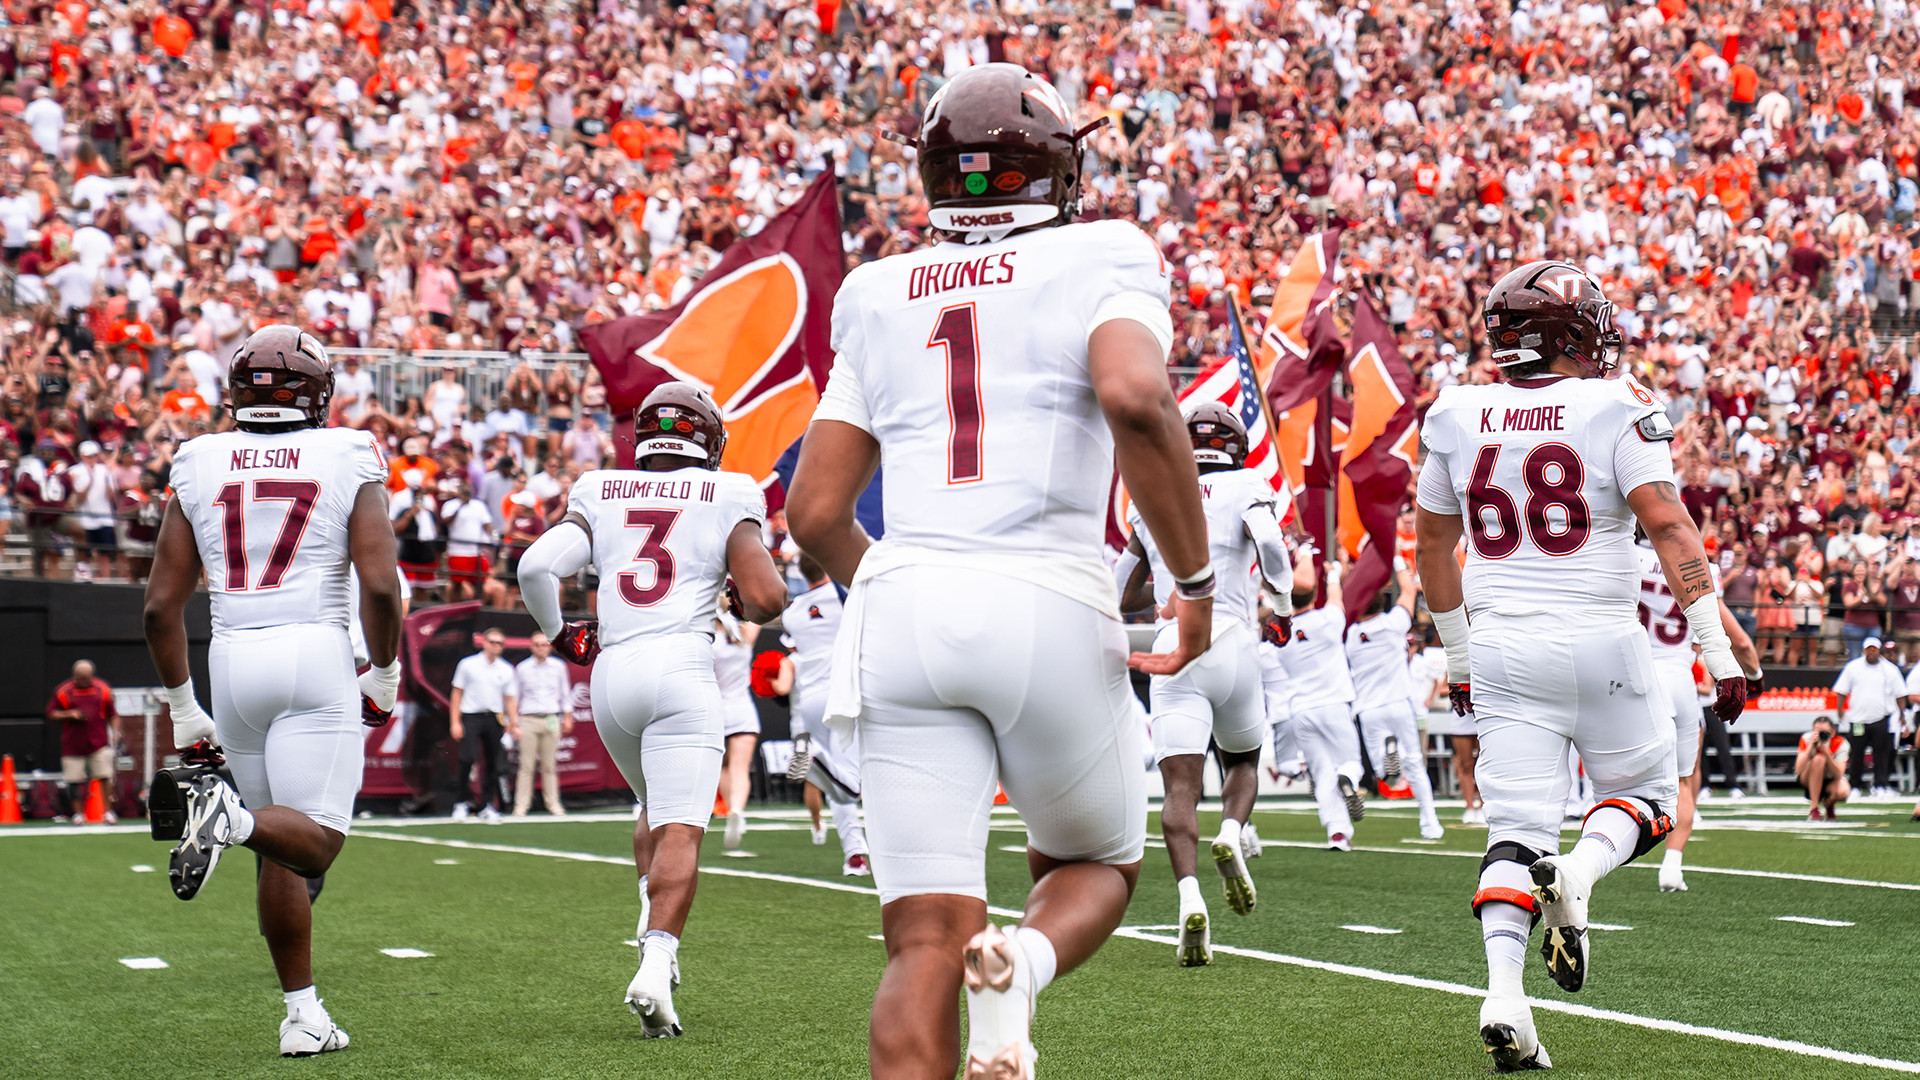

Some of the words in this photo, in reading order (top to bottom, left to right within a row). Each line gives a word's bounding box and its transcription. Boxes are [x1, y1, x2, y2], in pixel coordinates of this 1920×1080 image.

[950, 211, 1015, 227] HOKIES
[908, 251, 1017, 300] DRONES
[1537, 272, 1588, 303] VT
[926, 301, 985, 485] 1
[249, 411, 281, 419] HOKIES
[1480, 407, 1496, 433] K.
[1502, 405, 1565, 432] MOORE
[230, 447, 300, 471] NELSON
[648, 442, 684, 451] HOKIES
[601, 480, 692, 501] BRUMFIELD
[700, 481, 716, 503] III
[1466, 441, 1591, 560] 68
[212, 478, 321, 591] 17
[617, 507, 683, 608] 3
[1757, 695, 1827, 710] GATORADE
